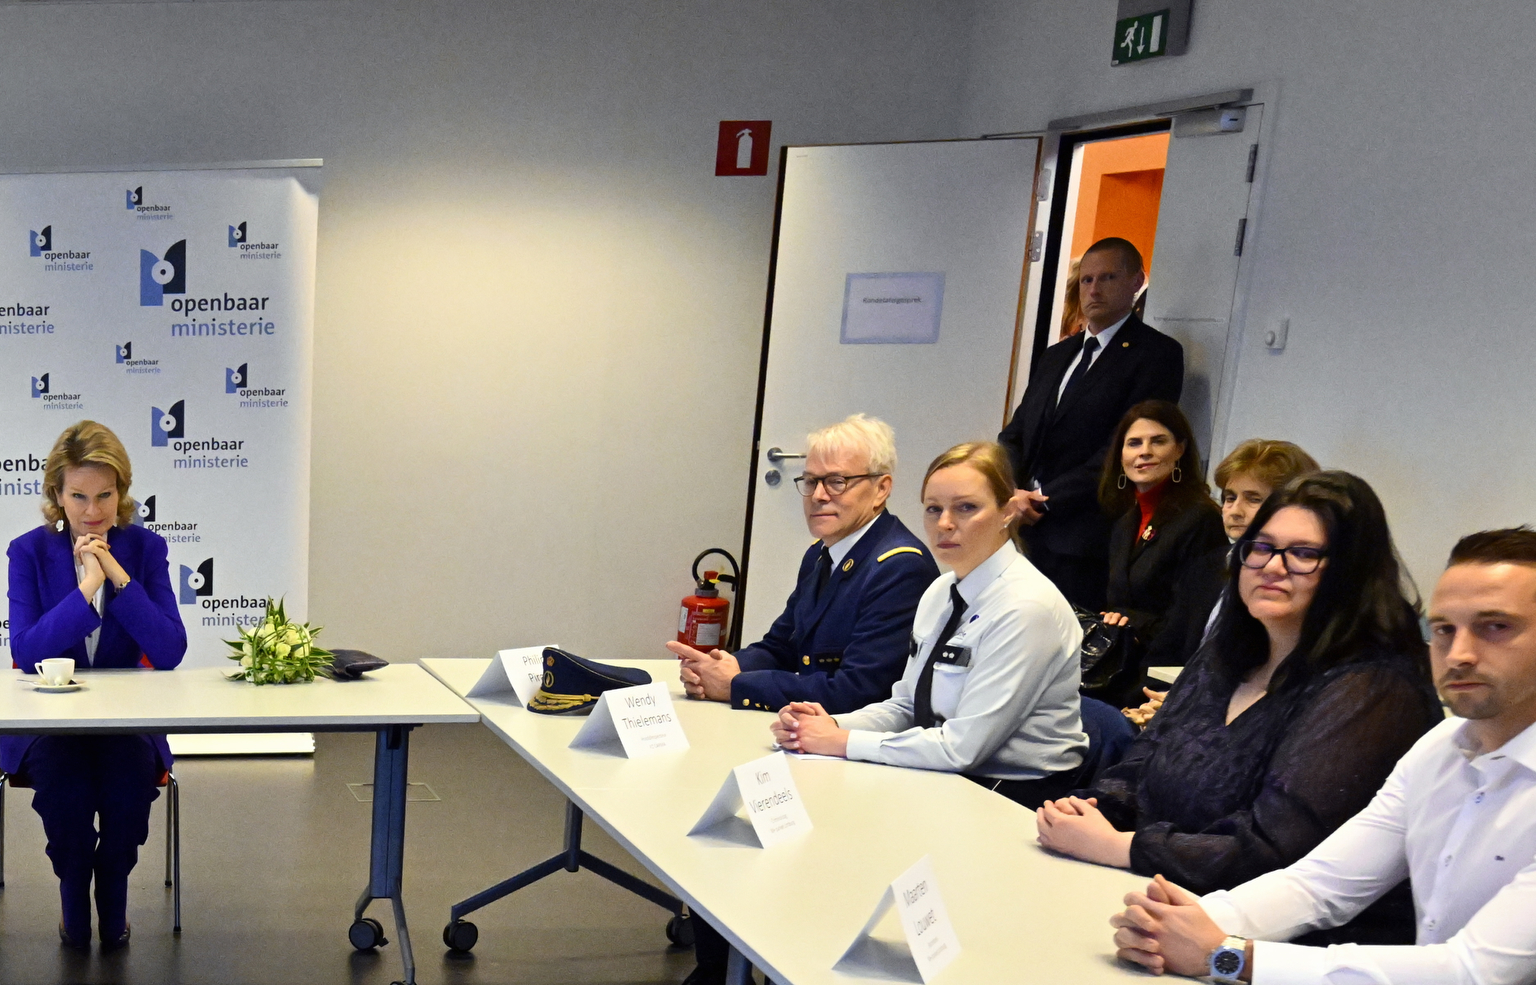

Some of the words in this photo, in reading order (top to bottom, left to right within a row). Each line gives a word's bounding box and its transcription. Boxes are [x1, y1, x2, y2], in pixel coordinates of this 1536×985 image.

[137, 204, 171, 213] openbaar
[240, 242, 279, 252] openbaar
[44, 250, 91, 262] openbaar
[240, 250, 282, 260] ministerie
[45, 261, 94, 272] ministerie
[171, 293, 270, 314] openbaar
[171, 317, 276, 337] ministerie
[126, 358, 159, 367] openbaar
[43, 392, 82, 402] openbaar
[240, 386, 286, 399] openbaar
[43, 401, 84, 410] ministerie
[240, 398, 288, 408] ministerie
[174, 438, 244, 454] openbaar
[174, 454, 249, 469] ministerie
[148, 522, 198, 533] openbaar
[202, 613, 266, 627] minister
[528, 672, 544, 682] Pira
[624, 693, 656, 708] Wendy
[622, 713, 672, 730] Thielemans
[755, 770, 772, 785] Kim
[749, 788, 794, 814] Vierendeels
[902, 880, 929, 908] Maarten
